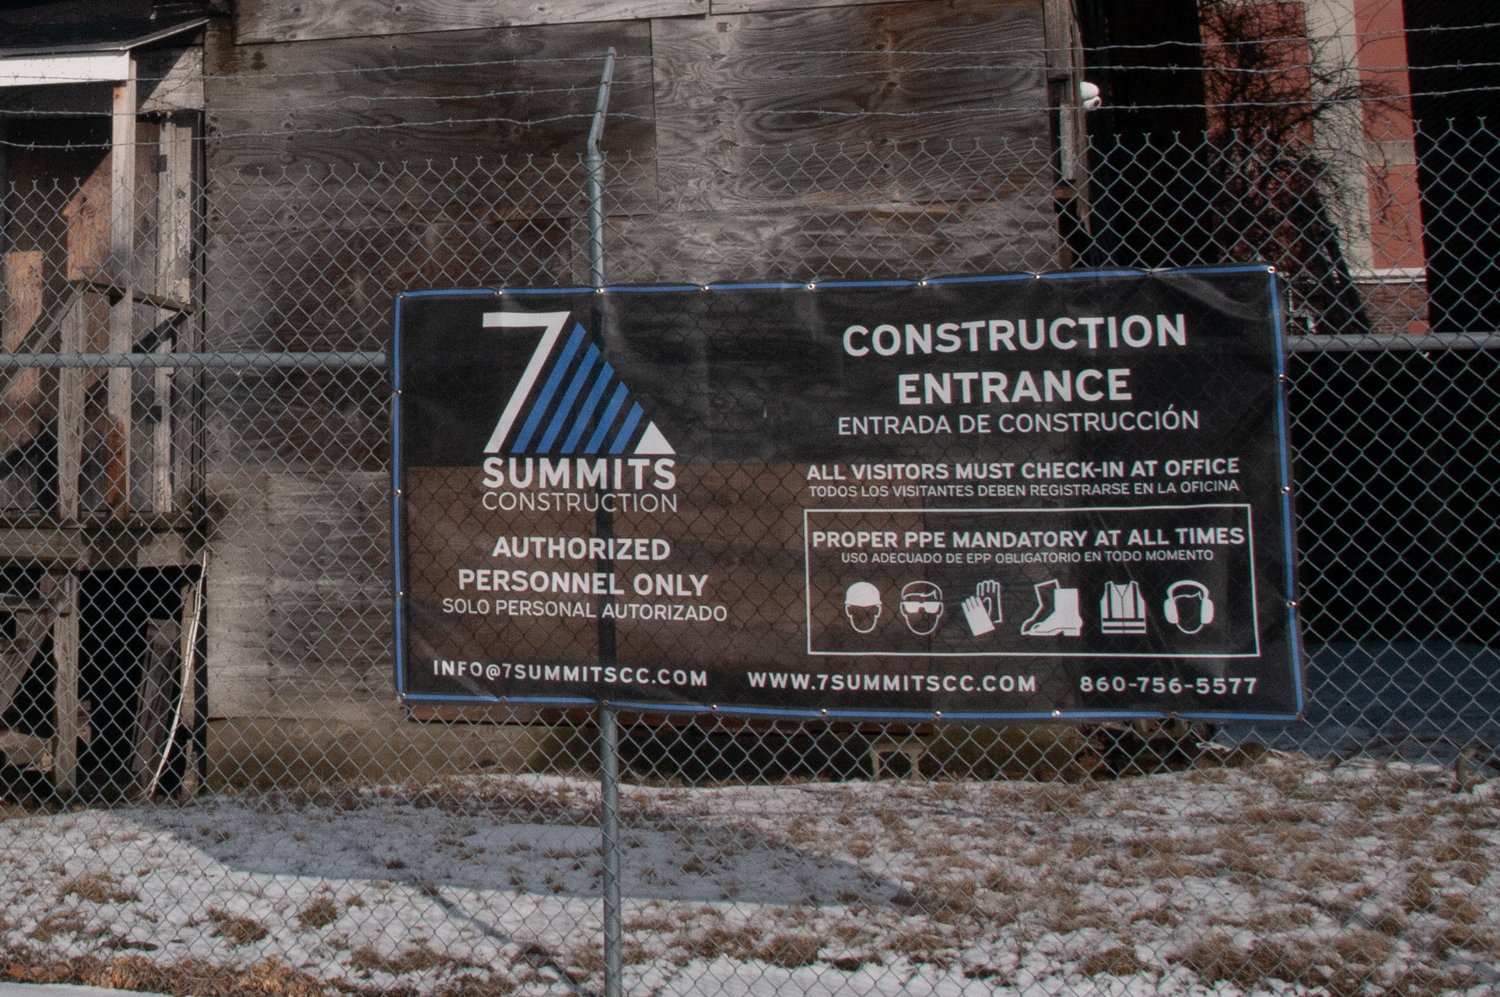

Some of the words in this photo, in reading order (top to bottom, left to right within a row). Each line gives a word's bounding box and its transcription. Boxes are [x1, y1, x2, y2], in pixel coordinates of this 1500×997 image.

[843, 314, 1185, 356] CONSTRUCTION
[483, 311, 570, 453] 7
[899, 369, 1131, 404] ENTRANCE
[839, 415, 951, 435] ENTRADA
[960, 415, 990, 433] DE
[999, 404, 1198, 432] CONSTRUCCIÓN
[483, 457, 675, 490] SUMMITS
[807, 465, 846, 480] ALL
[851, 464, 948, 479] VISITORS
[956, 463, 1014, 479] MUST
[1022, 462, 1123, 478] CHECK-IN
[1131, 461, 1157, 476] AT
[1165, 458, 1239, 476] OFFICE
[809, 486, 857, 497] TODOS
[862, 486, 888, 497] LOS
[893, 485, 974, 497] VISITANTES
[978, 485, 1025, 496] DEBEN
[1030, 483, 1129, 496] REGISTRARSE
[1135, 483, 1153, 494] EN
[1158, 483, 1176, 493] LA
[1181, 480, 1239, 493] OFICINA
[483, 491, 676, 512] CONSTRUCTION
[492, 537, 670, 560] AUTHORIZED
[813, 532, 897, 547] PROPER
[905, 532, 945, 547] PPE
[953, 531, 1087, 548] MANDATORY
[1095, 530, 1121, 546] AT
[1128, 529, 1169, 545] ALL
[1176, 528, 1244, 544] TIMES
[842, 553, 867, 563] USO
[872, 553, 942, 563] ADECUADO
[946, 553, 962, 563] DE
[967, 553, 991, 563] EPP
[995, 552, 1080, 563] OBLIGATORIO
[1085, 552, 1101, 561] EN
[1105, 551, 1141, 561] TODO
[1146, 550, 1213, 560] MOMENTO
[459, 569, 624, 594] PERSONNEL
[634, 573, 708, 596] ONLY
[443, 598, 489, 614] SOLO
[496, 600, 596, 617] PERSONAL
[602, 604, 727, 621] AUTORIZADO
[434, 660, 706, 685] INFO@7SUMMITSCC.COM
[748, 672, 1035, 691] WWW.7SUMMITSCC.COM
[1080, 676, 1256, 694] 860-756-5577
